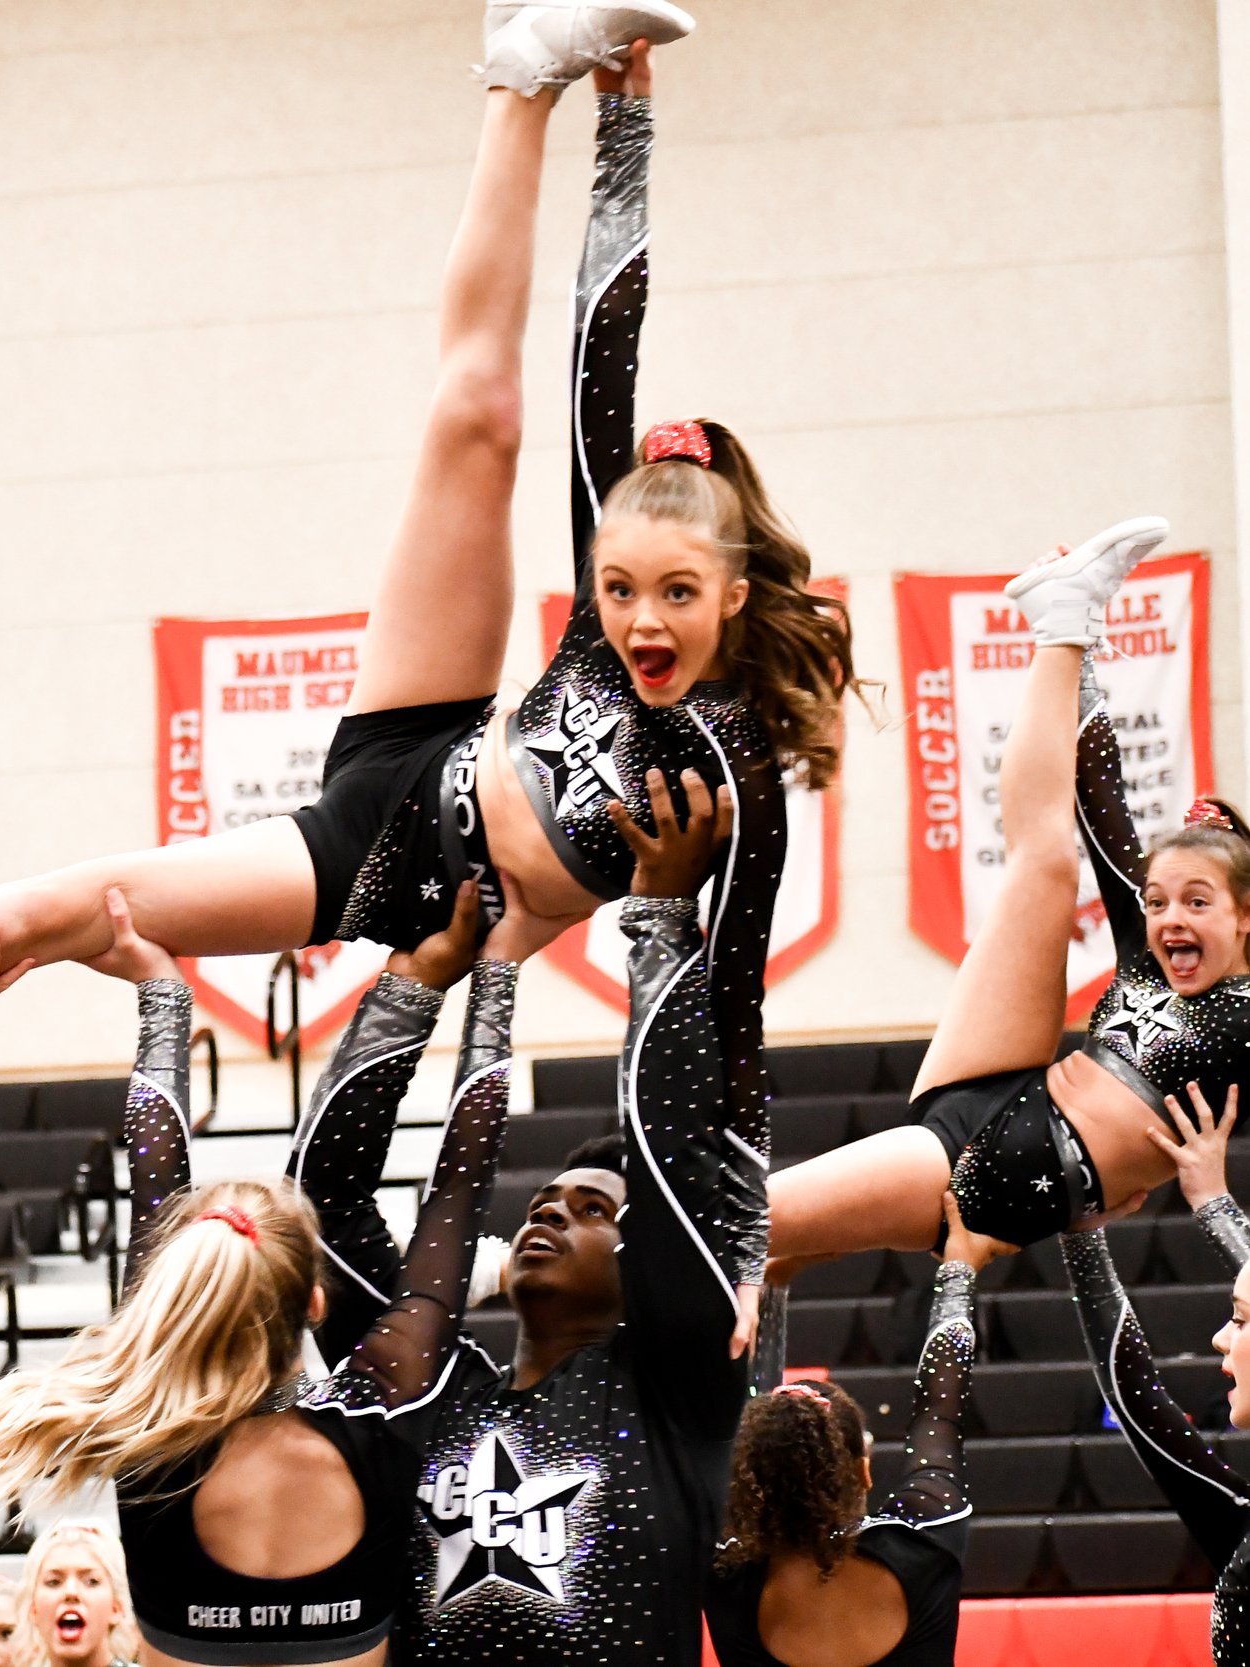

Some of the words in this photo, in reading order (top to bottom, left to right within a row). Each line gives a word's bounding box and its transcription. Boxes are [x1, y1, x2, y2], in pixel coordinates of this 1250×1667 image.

[984, 594, 1161, 634] MALLE
[236, 646, 359, 677] MAUMEL
[222, 685, 291, 712] HIGH
[168, 709, 207, 845] CCER
[562, 698, 601, 807] CCU
[916, 668, 959, 851] SOCCER
[1126, 988, 1163, 1046] CCU
[431, 1464, 567, 1567] CCU
[187, 1604, 241, 1629] CHEER
[250, 1603, 290, 1626] CITY
[301, 1599, 361, 1625] UNITED
